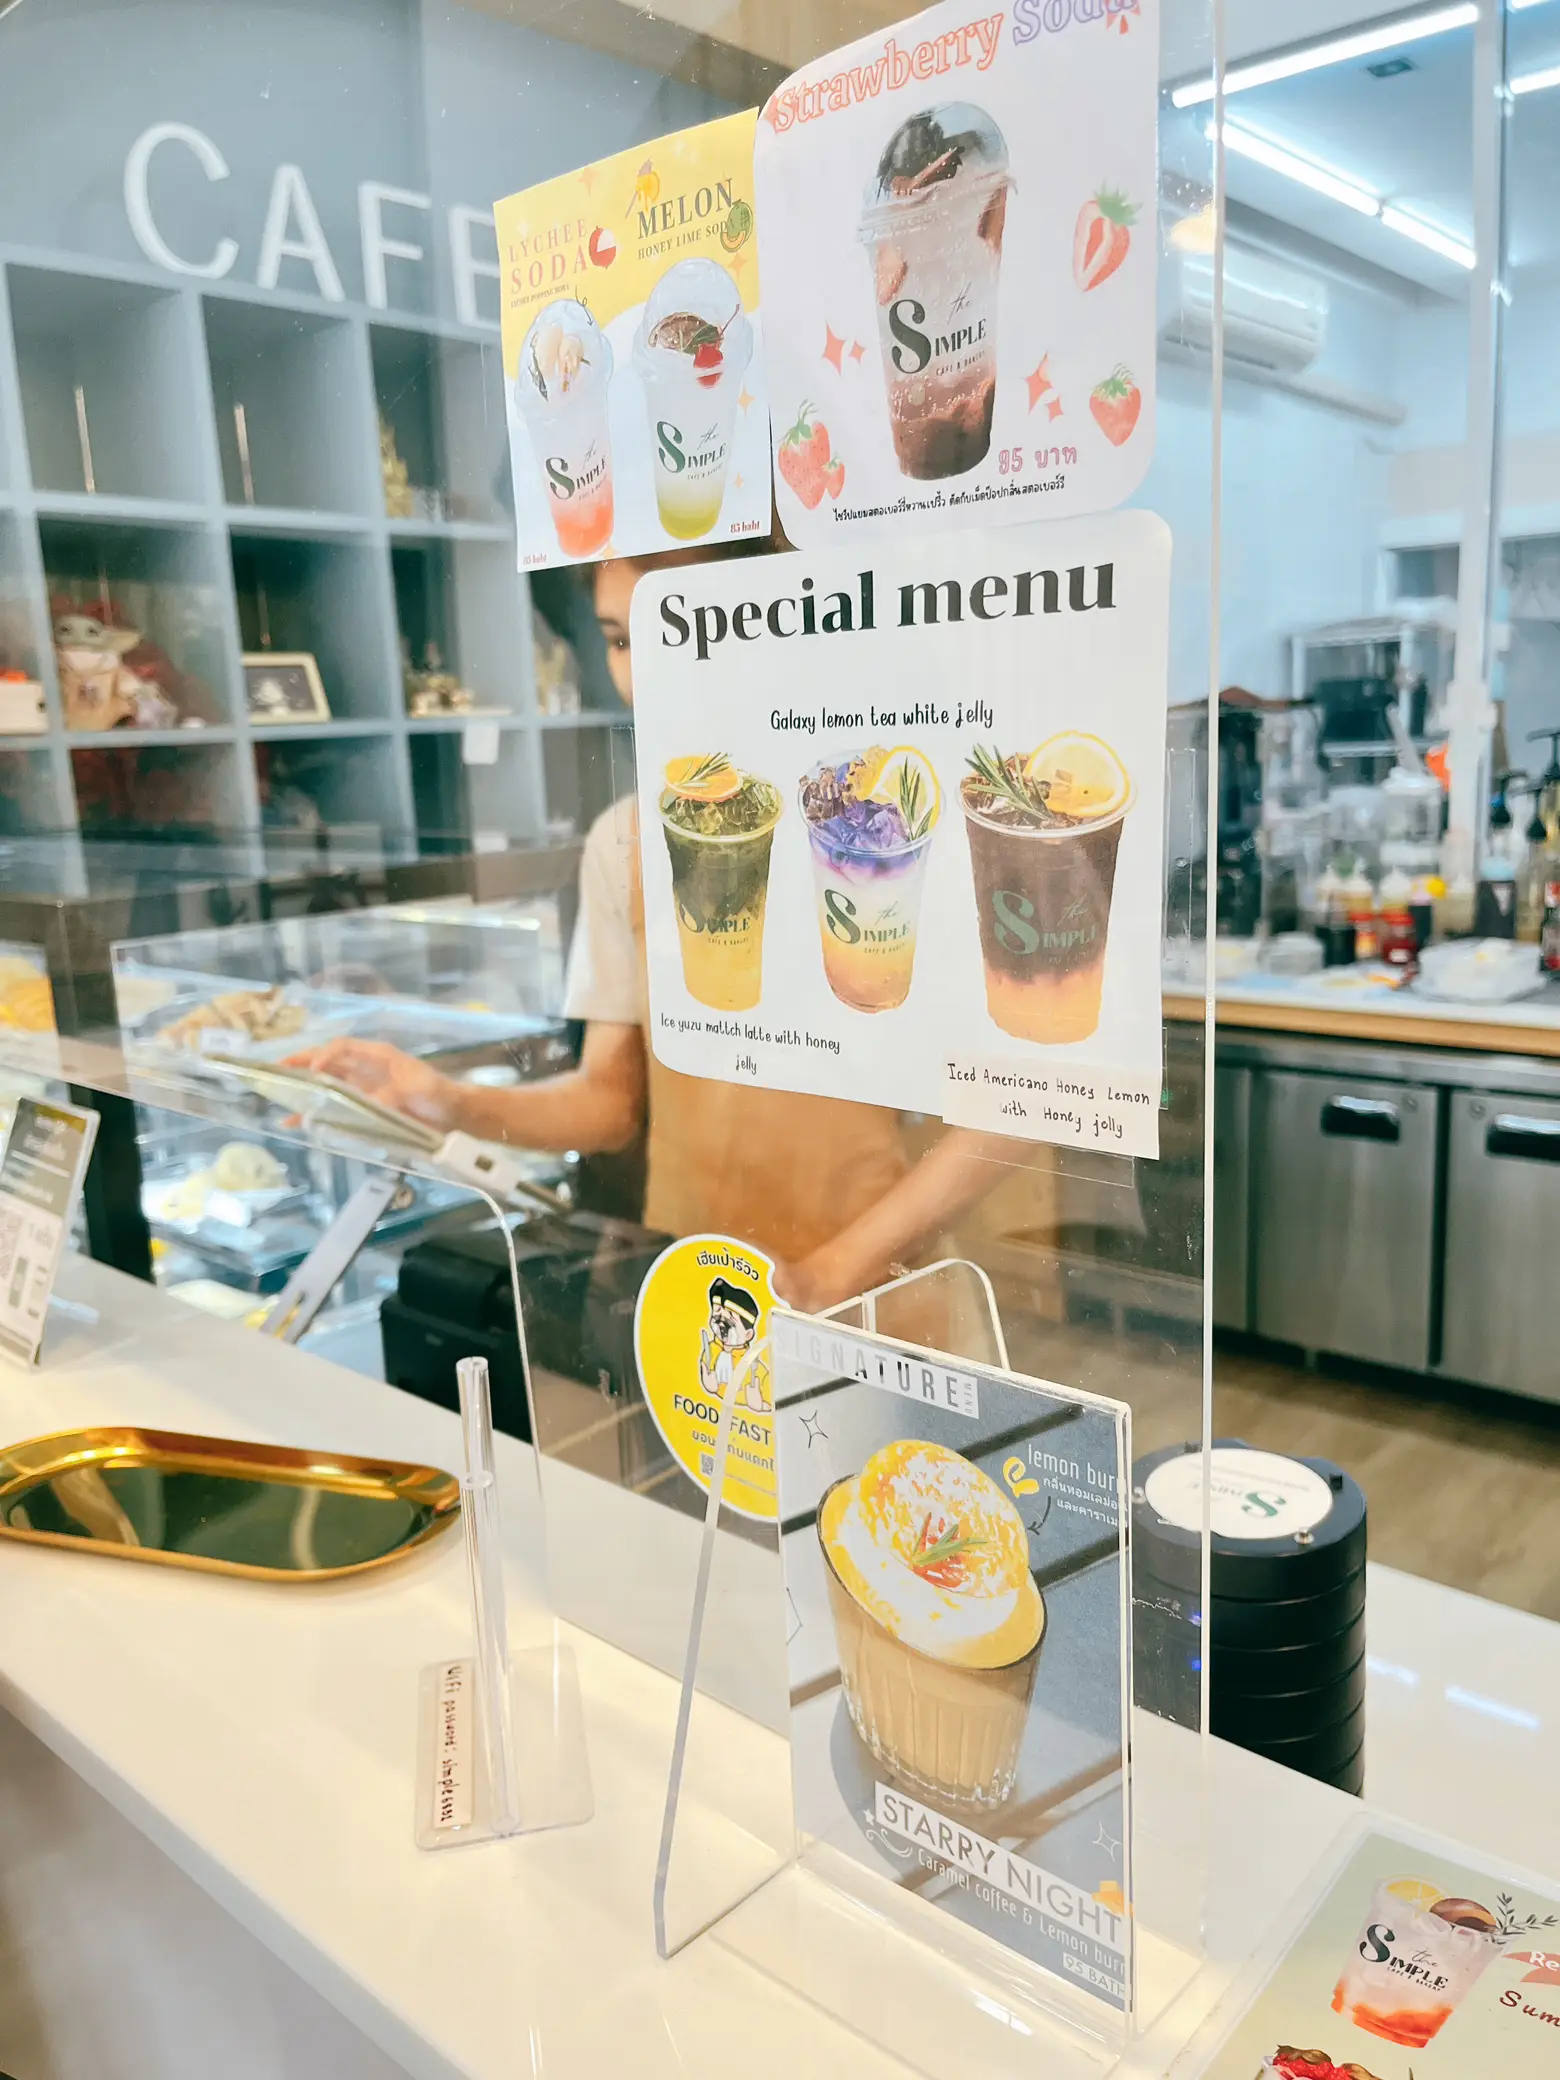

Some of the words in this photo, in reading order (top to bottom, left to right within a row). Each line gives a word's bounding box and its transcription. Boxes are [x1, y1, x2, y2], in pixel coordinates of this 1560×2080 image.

[773, 12, 1005, 134] Strawberry
[1013, 0, 1137, 46] So
[123, 120, 501, 332] CAFE
[637, 178, 734, 240] MELON
[508, 219, 588, 263] LYCHEE
[638, 239, 673, 260] HONEY
[676, 230, 702, 247] LIME
[511, 244, 588, 295] SODA
[946, 281, 973, 325] the
[889, 299, 987, 374] SIMPLE
[656, 421, 727, 474] SIMPLE
[1034, 446, 1078, 469] บาท
[545, 454, 608, 500] SIMPLE
[730, 523, 741, 533] 85
[742, 520, 760, 532] baht
[659, 570, 877, 661] Special
[896, 562, 1118, 628] menu
[770, 708, 816, 735] Galaxy
[821, 707, 864, 730] lemon
[870, 705, 897, 727] tea
[901, 702, 950, 727] white
[956, 699, 994, 730] jelly
[824, 889, 911, 944] SIMPLE
[661, 1013, 676, 1029] Ice
[678, 1018, 702, 1033] yuzu
[705, 1020, 742, 1038] mattch
[744, 1023, 772, 1043] latte
[775, 1030, 801, 1046] with
[806, 1031, 841, 1055] honey
[735, 1054, 758, 1075] jelly
[947, 1063, 977, 1082] Iced
[983, 1068, 1048, 1092] Americano
[1056, 1077, 1095, 1101] Honey
[1107, 1086, 1151, 1105] Lemon
[999, 1102, 1027, 1118] with
[1043, 1106, 1083, 1133] Honey
[776, 1328, 959, 1408] SIGNATURE
[674, 1395, 719, 1425] FOOD
[963, 1382, 973, 1415] MENU
[1027, 1443, 1080, 1481] lemon
[1087, 1461, 1120, 1494] bur
[1043, 1475, 1121, 1511] กลิ่นหอมเลม่อ
[1056, 1498, 1121, 1528] และคาราเม
[883, 1794, 996, 1877] STARRY
[1007, 1857, 1122, 1944] NIGHT
[918, 1848, 971, 1891] Caramel
[975, 1881, 1017, 1918] coffee
[1039, 1914, 1088, 1957] Lemon
[1065, 1955, 1083, 1975] 95
[1359, 1923, 1449, 1989] SIMPLE
[1528, 1950, 1560, 1972] Re
[1498, 1989, 1560, 2028] Sum
